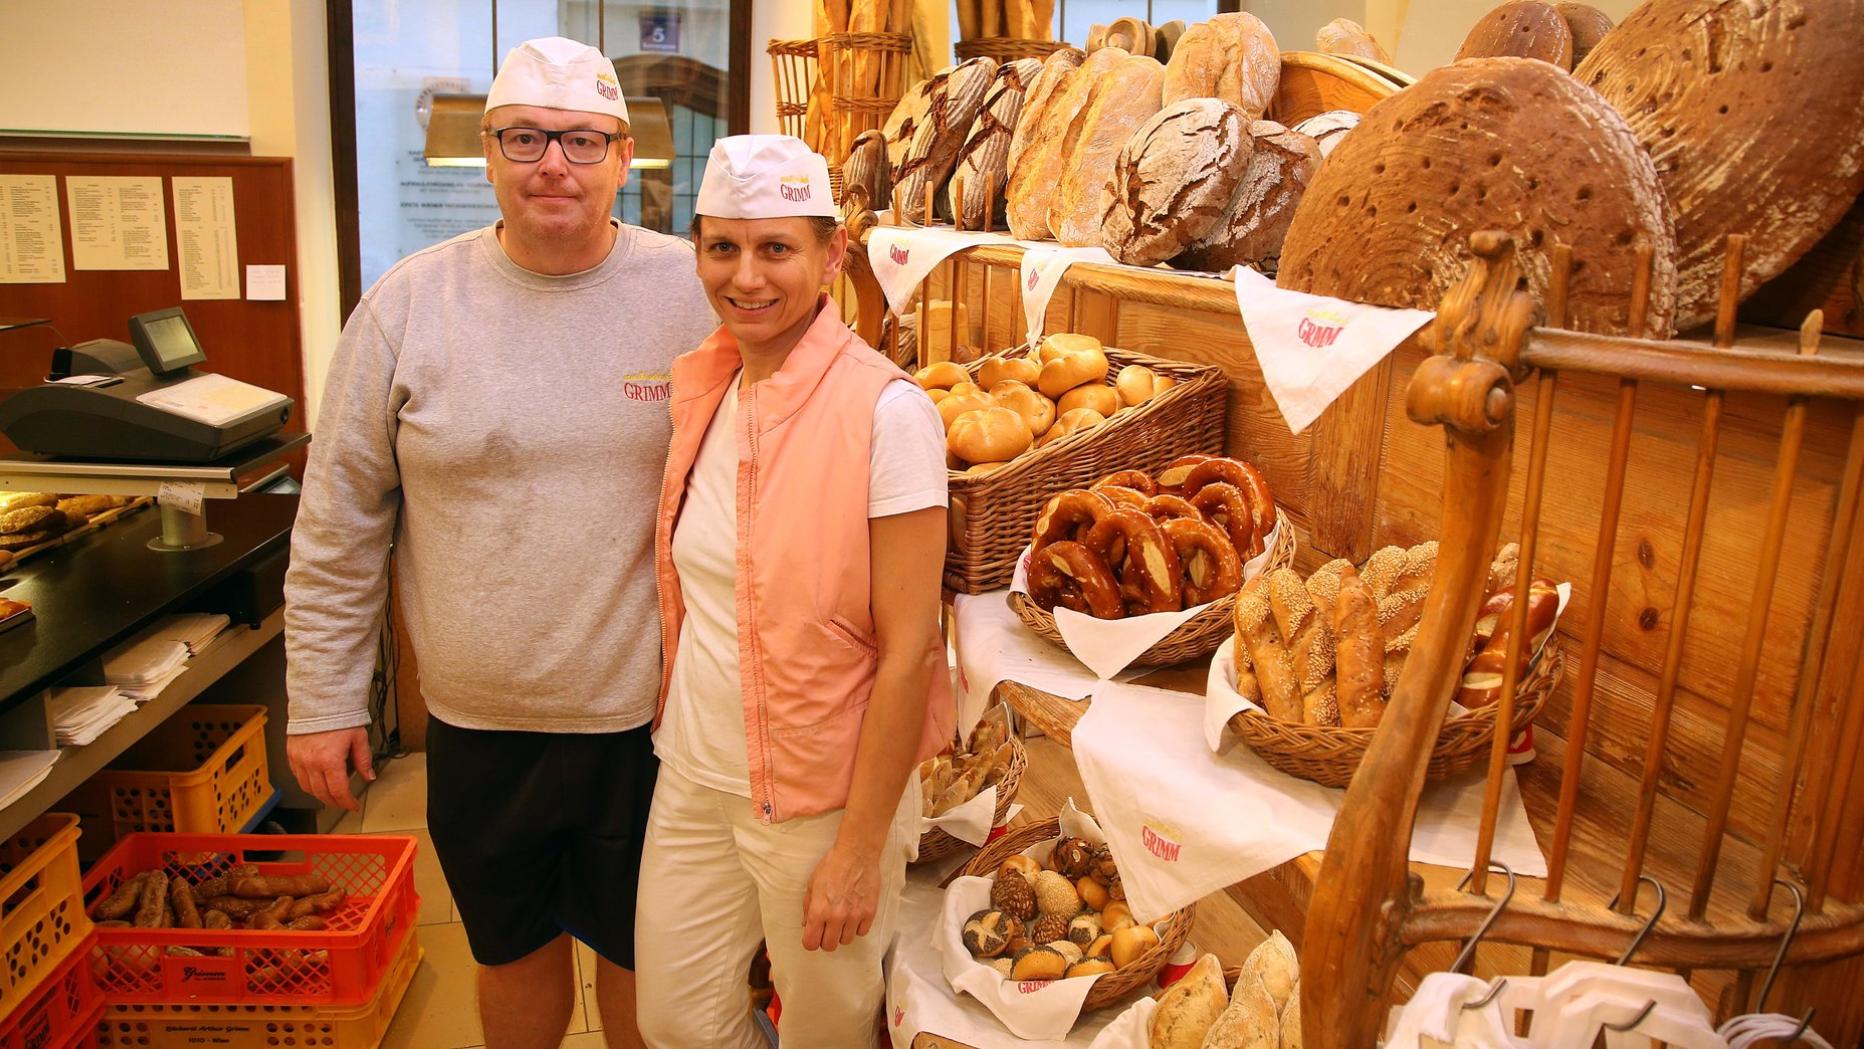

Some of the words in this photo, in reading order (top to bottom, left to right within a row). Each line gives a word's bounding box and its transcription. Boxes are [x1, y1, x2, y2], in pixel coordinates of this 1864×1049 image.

[653, 27, 665, 43] 5
[596, 79, 618, 101] GRIMM
[780, 183, 811, 202] GRIMM
[1298, 317, 1344, 348] GRIMM
[624, 382, 672, 402] GRIMM
[1141, 825, 1182, 862] GRIMM
